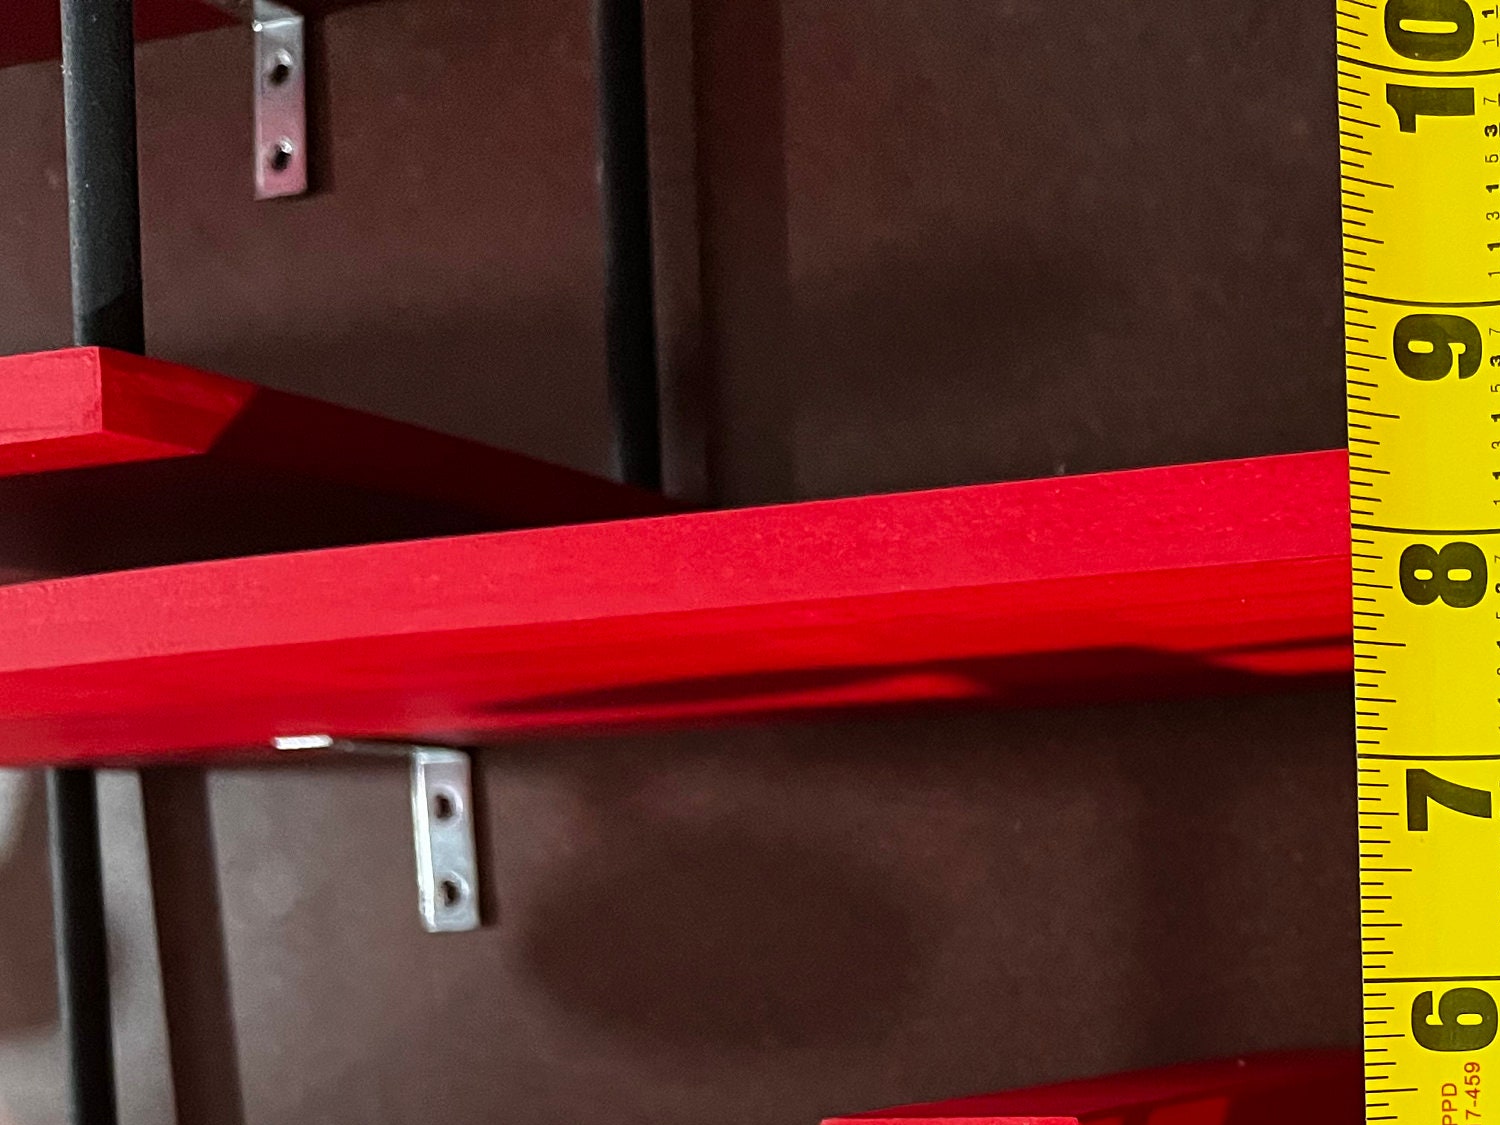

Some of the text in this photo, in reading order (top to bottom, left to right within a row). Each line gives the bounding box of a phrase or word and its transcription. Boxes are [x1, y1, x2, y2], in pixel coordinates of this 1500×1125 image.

[1384, 0, 1475, 133] 10
[1393, 313, 1483, 381] 9
[1399, 541, 1488, 609] 8
[1406, 768, 1493, 832] 7
[1412, 987, 1499, 1052] 6
